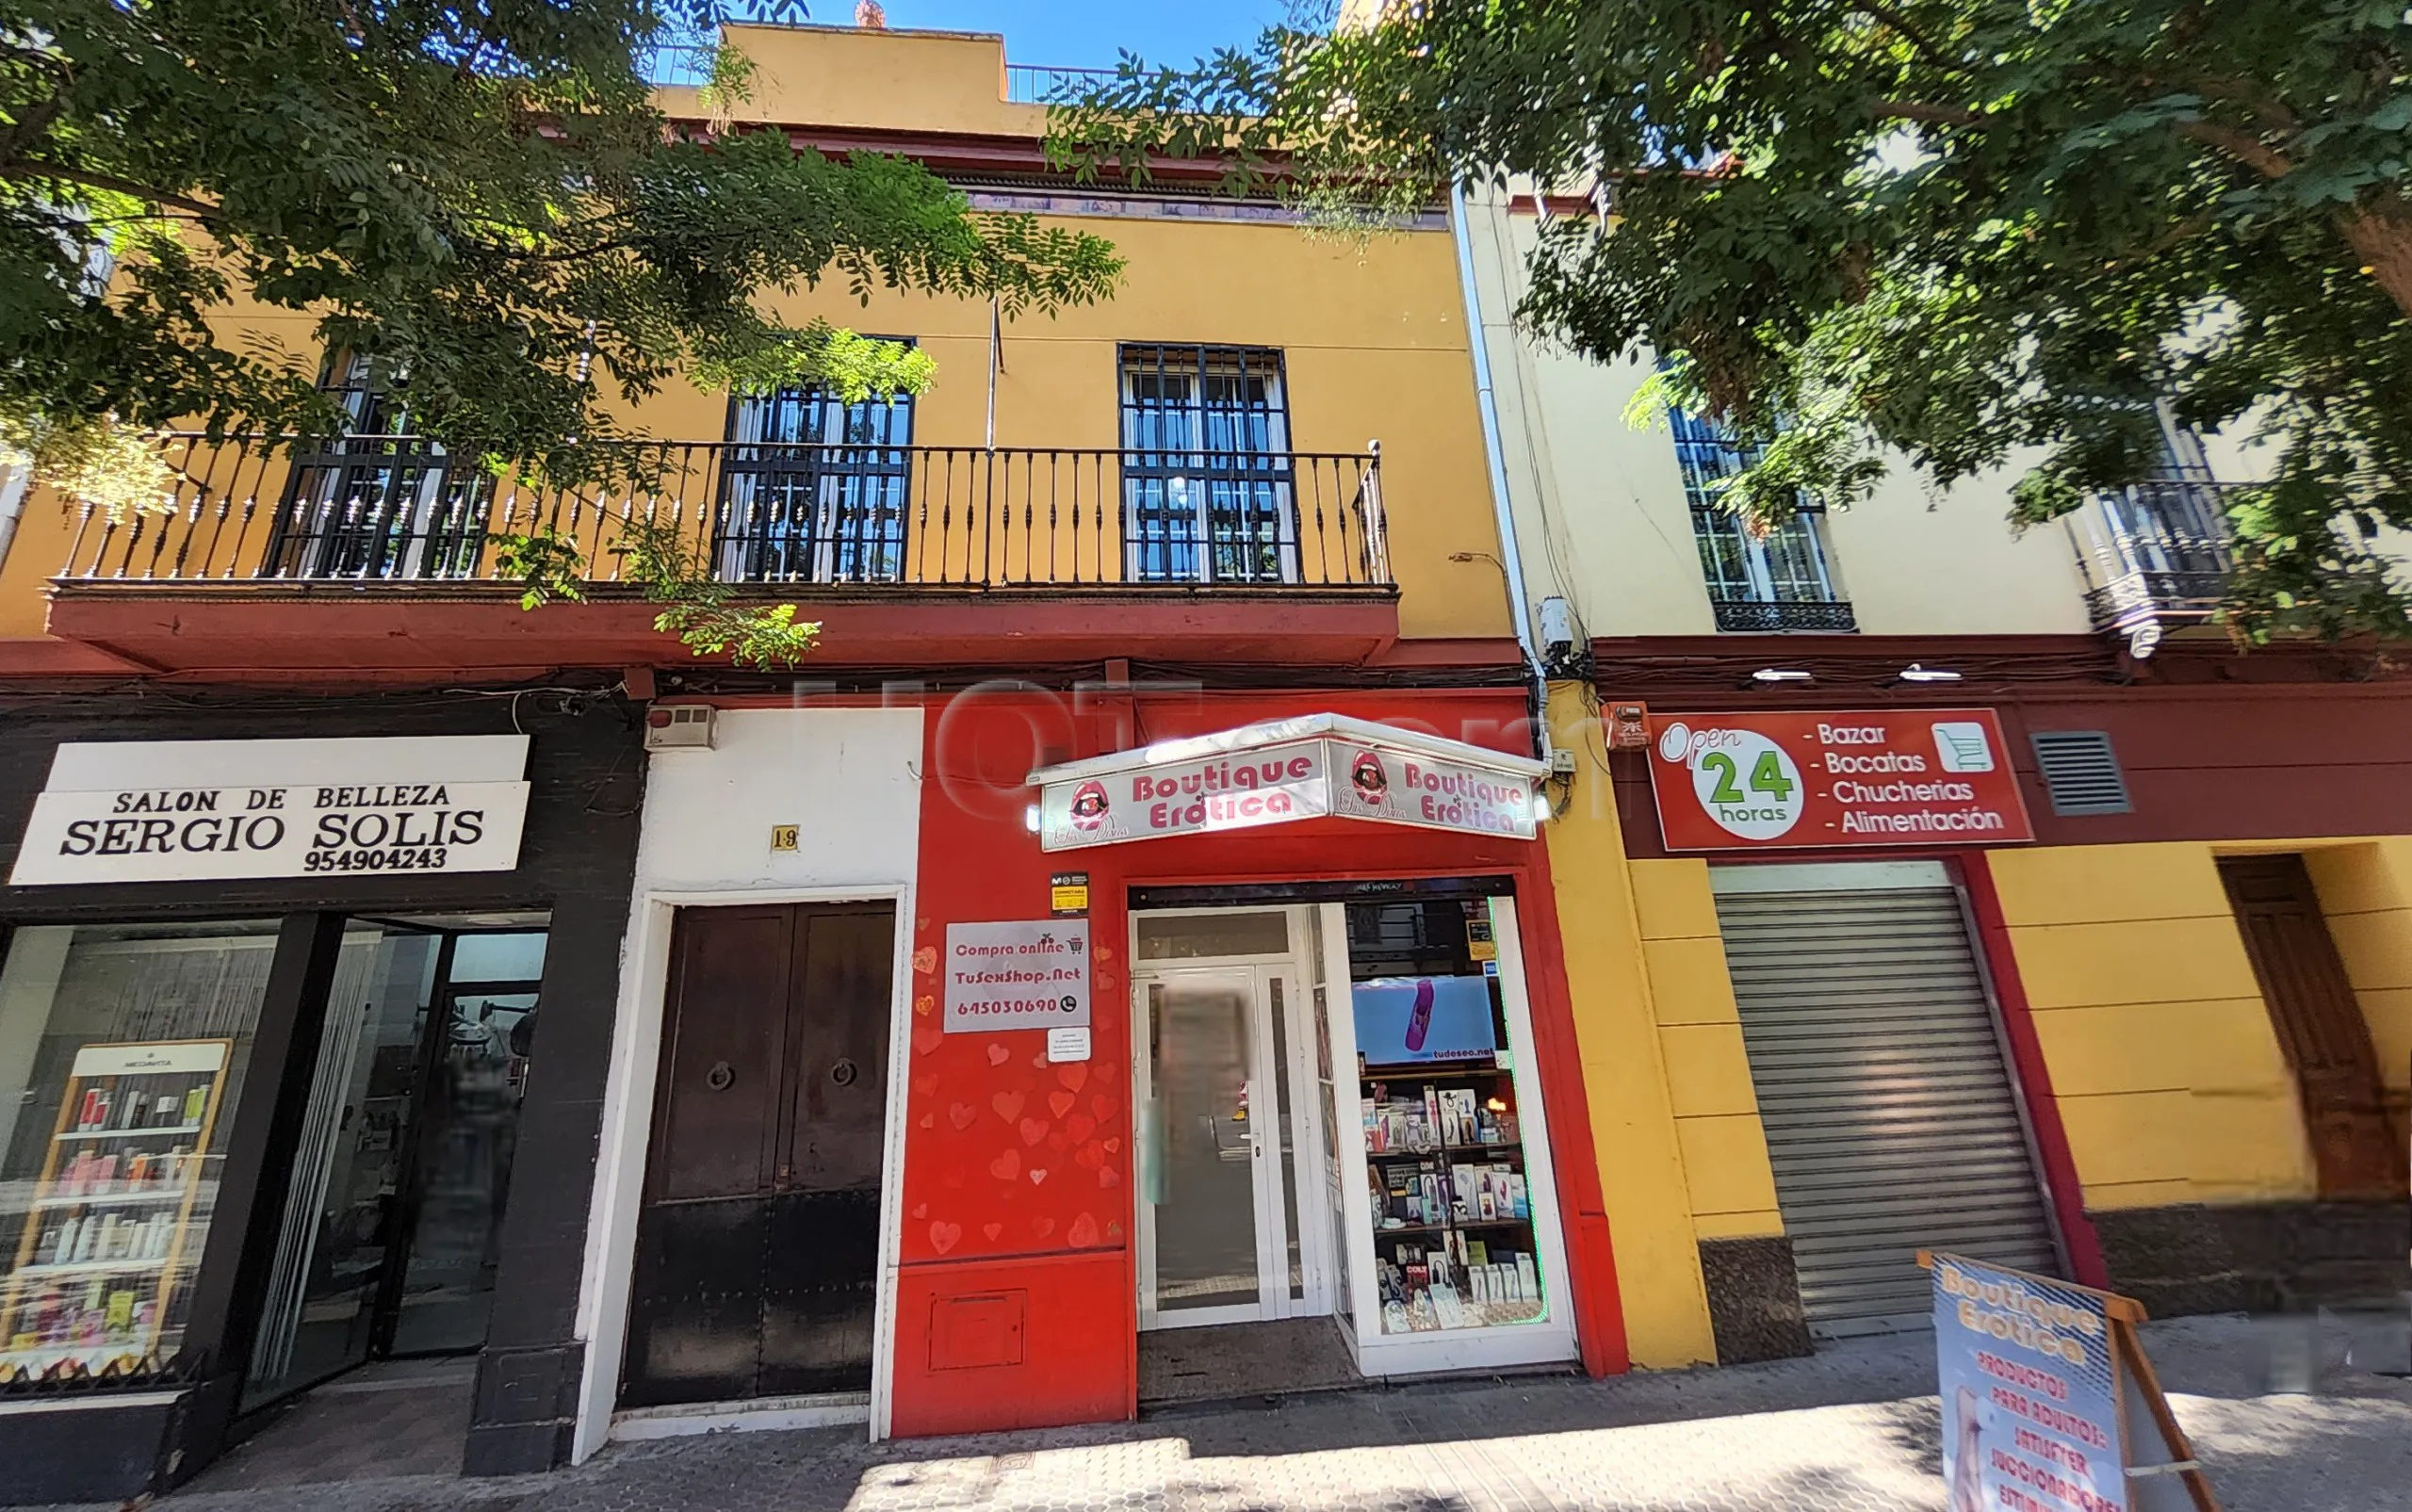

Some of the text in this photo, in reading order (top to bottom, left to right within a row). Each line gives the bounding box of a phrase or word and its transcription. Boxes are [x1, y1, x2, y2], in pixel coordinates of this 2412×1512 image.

[1659, 722, 1742, 770] Open
[1817, 723, 1885, 745] Bazar
[1825, 752, 1927, 774] Bocatas
[1133, 757, 1313, 803] Boutique
[1404, 762, 1523, 807] Boutique
[1702, 751, 1794, 804] 24
[113, 785, 450, 813] SALON DE BELLEZA
[1718, 804, 1787, 822] horas
[59, 809, 484, 855] SERGIO SOLIS
[1841, 806, 2003, 834] Alimentación
[774, 830, 796, 847] 19
[304, 849, 447, 872] 954904243
[955, 940, 1065, 958] Compra online
[954, 967, 1081, 984] TuSexShop.Net
[957, 999, 1057, 1016] 645030690
[1433, 1048, 1494, 1059] tudeseo.net
[1942, 1265, 2104, 1335] Boutique
[1977, 1351, 2069, 1401] PRODUCTOS
[1991, 1386, 2028, 1416] PARA
